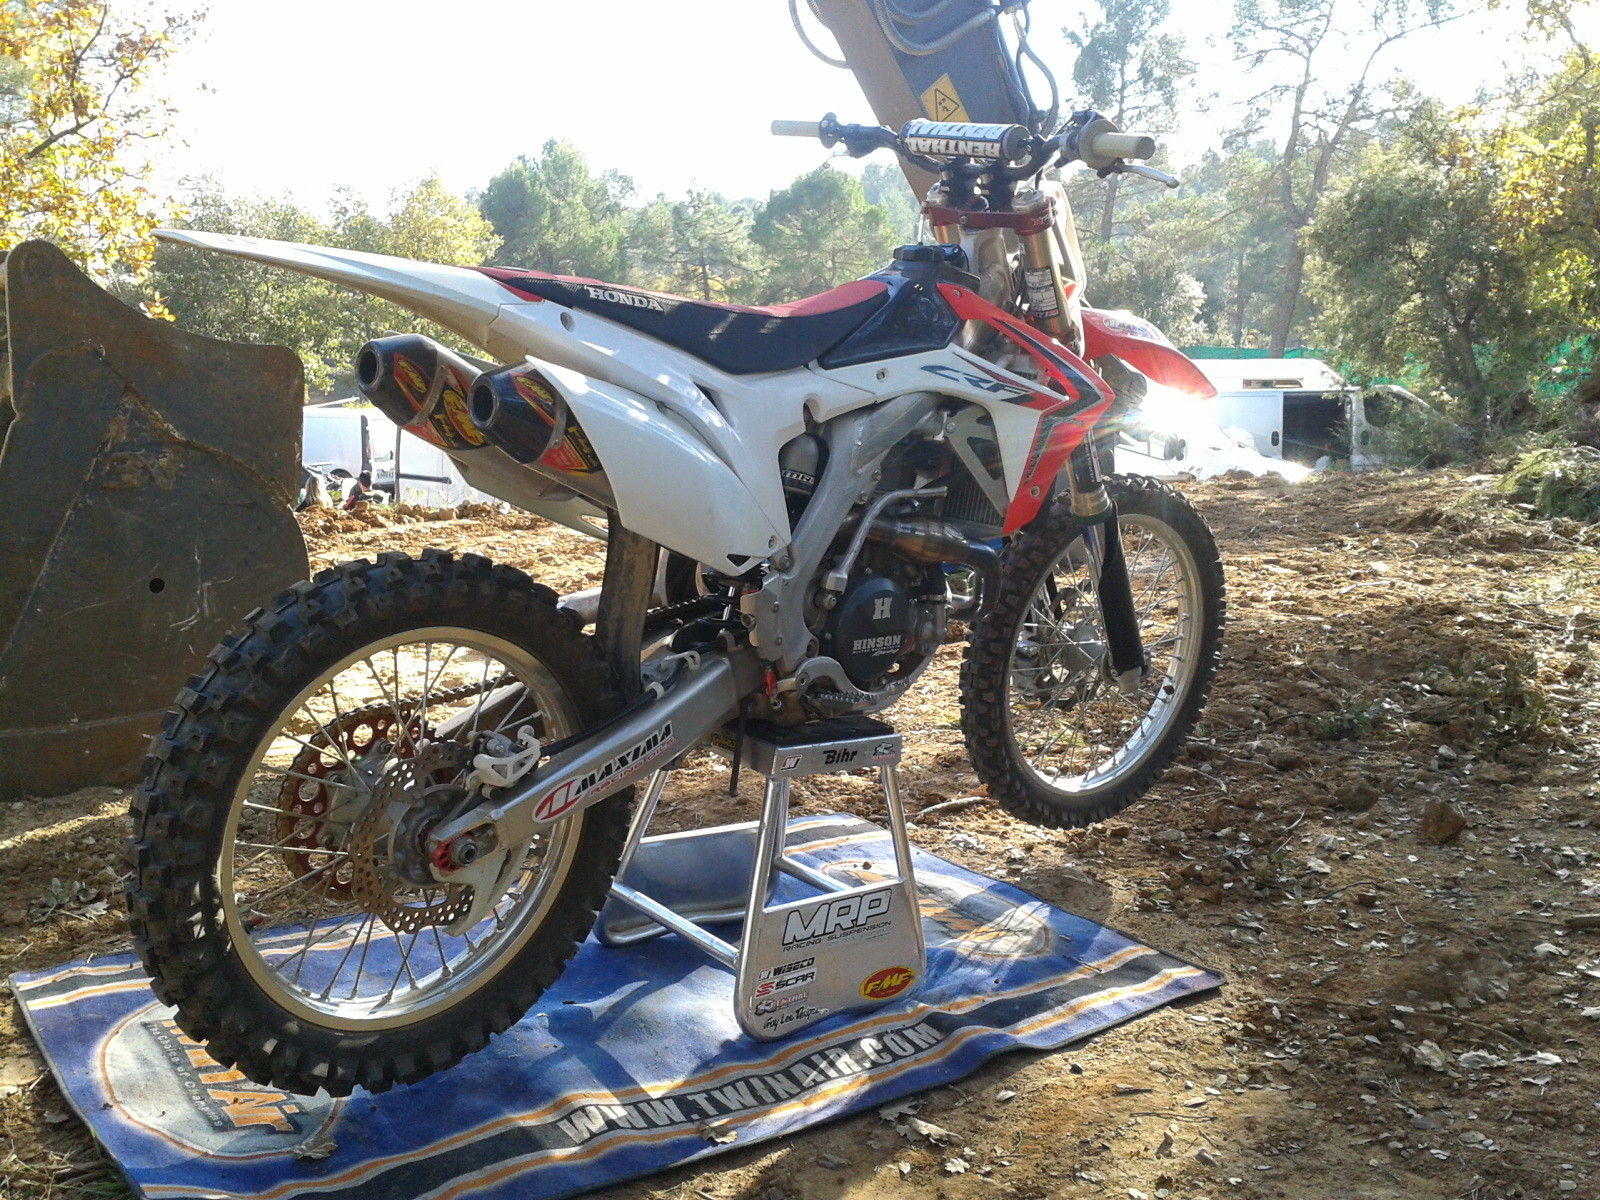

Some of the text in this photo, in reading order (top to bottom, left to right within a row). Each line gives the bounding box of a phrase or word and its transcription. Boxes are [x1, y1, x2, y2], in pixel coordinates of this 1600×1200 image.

[905, 137, 1001, 158] RENTHAL
[583, 284, 665, 312] HONDA
[920, 365, 1033, 395] CRF
[852, 634, 902, 651] HINSON
[574, 723, 673, 796] MAXIMA
[589, 737, 675, 796] RACING OILS
[822, 748, 858, 765] Bihr
[782, 888, 893, 947] MRP
[782, 937, 822, 952] RACING
[827, 920, 892, 941] SUSPENSION
[774, 971, 816, 990] SCAR
[865, 971, 914, 995] FMF
[555, 1021, 943, 1145] WWW.TWINAIR.COM
